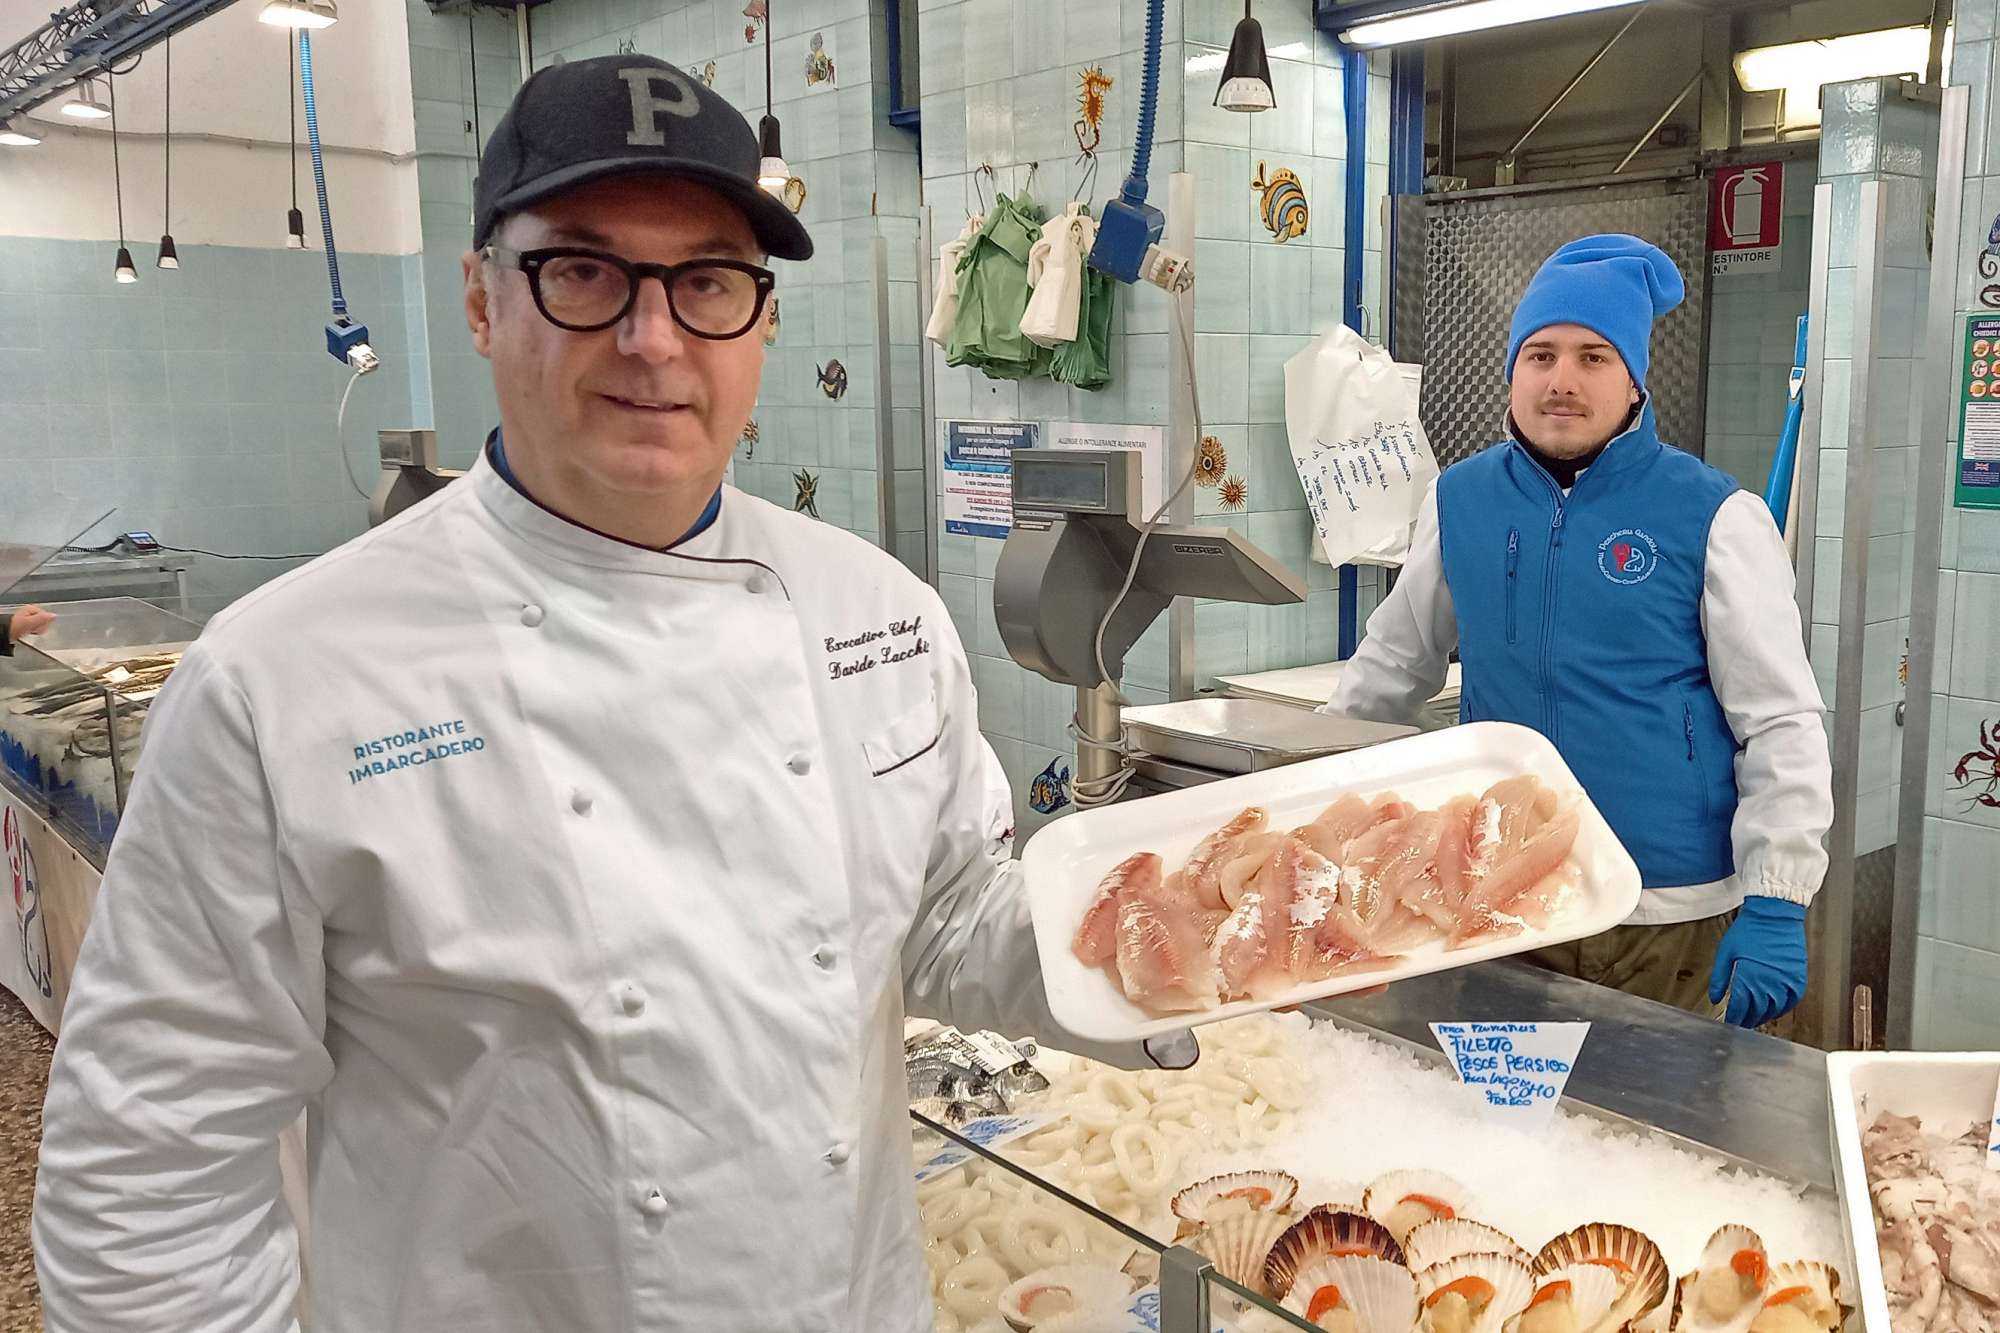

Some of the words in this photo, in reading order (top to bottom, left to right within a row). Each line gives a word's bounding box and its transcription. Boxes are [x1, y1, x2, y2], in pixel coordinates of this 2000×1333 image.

[617, 67, 700, 146] P
[1714, 250, 1772, 264] ESTINTORE
[823, 630, 887, 654] Executive
[888, 615, 922, 637] Chef
[828, 654, 877, 681] Davide
[353, 719, 466, 761] RISTORANTE
[348, 736, 486, 785] IMBARCADERO
[1450, 1035, 1513, 1053] FILETTO
[1456, 1053, 1498, 1073] PESCE
[1505, 1054, 1569, 1074] PERSICO
[1508, 1084, 1556, 1099] COMO
